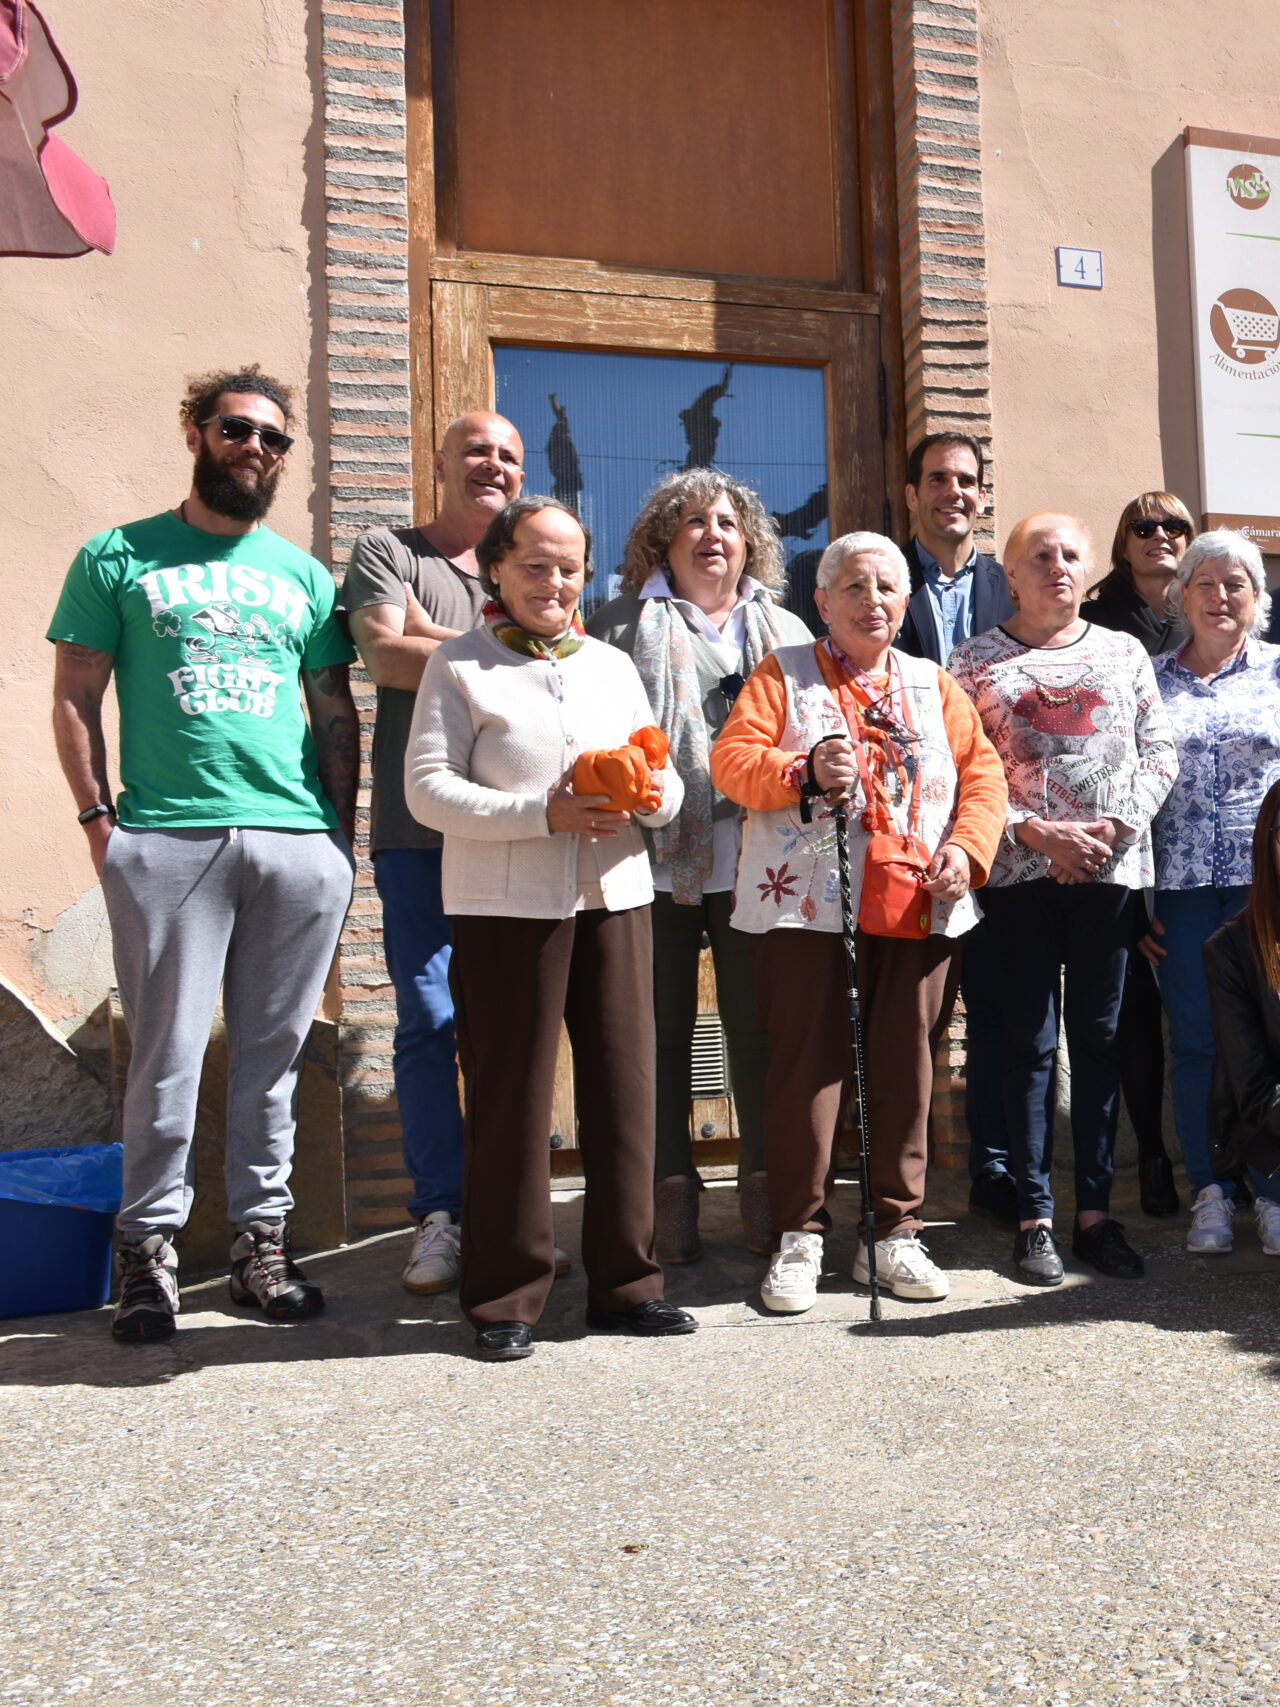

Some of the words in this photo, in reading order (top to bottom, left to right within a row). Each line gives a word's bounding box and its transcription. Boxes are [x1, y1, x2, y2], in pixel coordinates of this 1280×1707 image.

[1074, 256, 1087, 280] 4
[137, 562, 311, 628] IRISH
[167, 664, 285, 698] FIGHT
[178, 690, 275, 718] CLUB
[1070, 764, 1122, 797] SWEETBEAR
